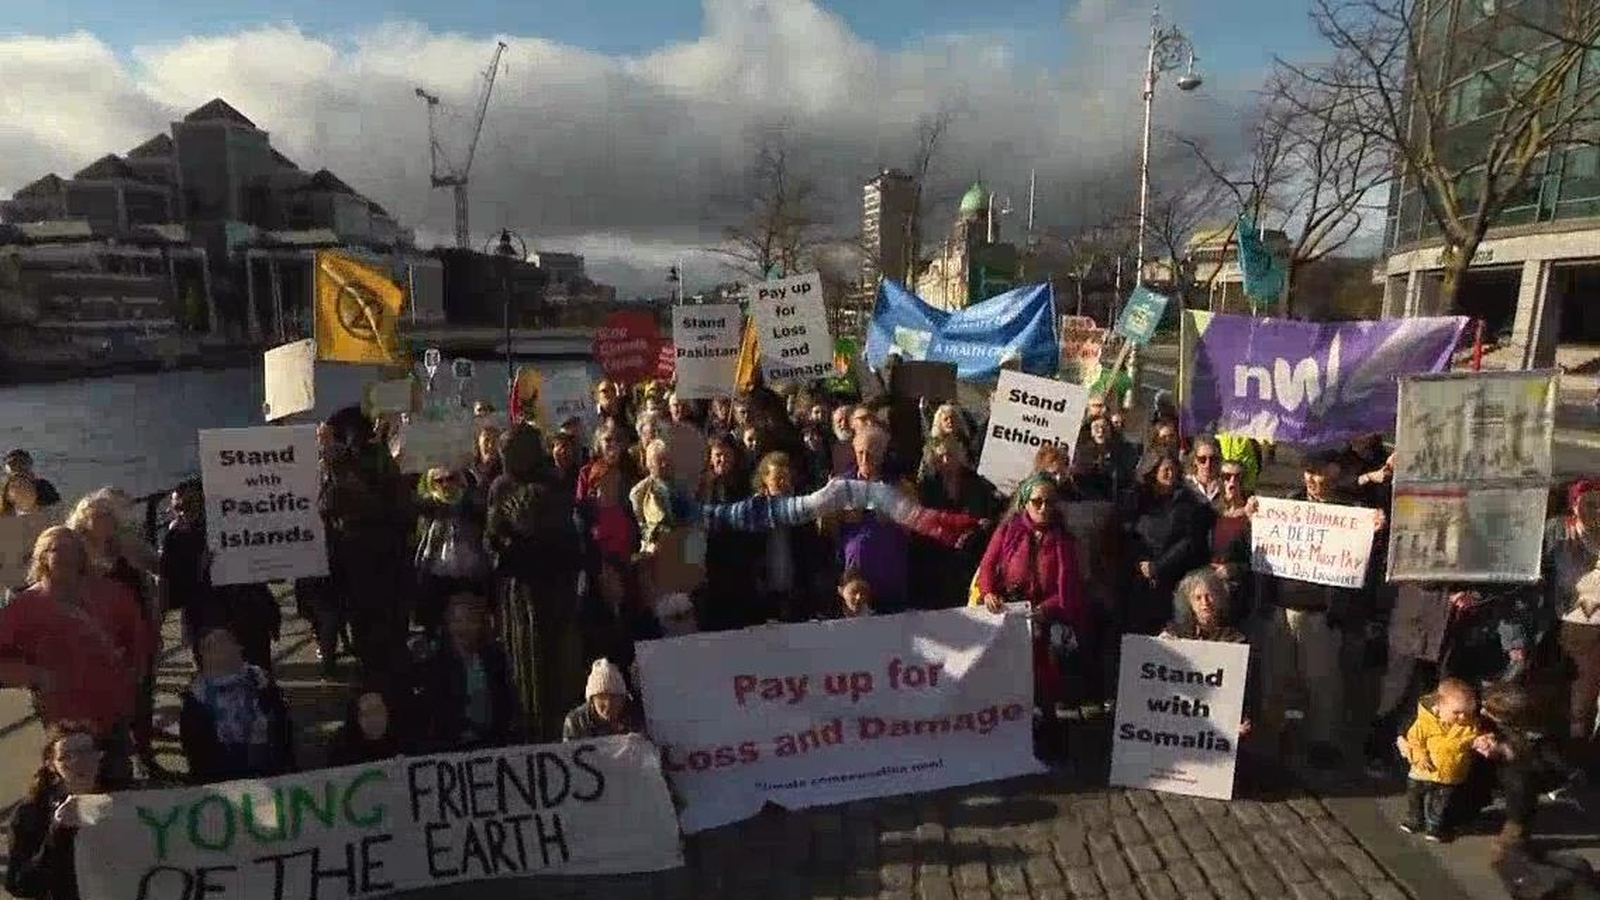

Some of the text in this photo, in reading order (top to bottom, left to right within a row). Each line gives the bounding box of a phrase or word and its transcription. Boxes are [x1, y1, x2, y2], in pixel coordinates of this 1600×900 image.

[759, 282, 812, 301] Pay up
[775, 305, 796, 317] for
[682, 317, 726, 329] Stand
[772, 326, 807, 339] Loss
[677, 345, 738, 358] Pakistan
[781, 343, 810, 358] and
[769, 361, 834, 380] Damage
[1009, 388, 1067, 414] Stand
[1022, 413, 1049, 427] with
[220, 445, 295, 466] Stand
[246, 474, 281, 487] with
[221, 492, 310, 517] Pacific
[220, 525, 315, 548] Islands
[1269, 524, 1330, 544] A DEBT
[733, 658, 945, 706] Pay up for
[1140, 662, 1224, 687] Stand
[1147, 695, 1210, 718] with
[660, 701, 1024, 773] Loss and Damage
[1119, 722, 1231, 752] Somalia
[136, 744, 605, 860] YOUNG FRIENDS
[136, 813, 570, 900] OF THE EARTH
